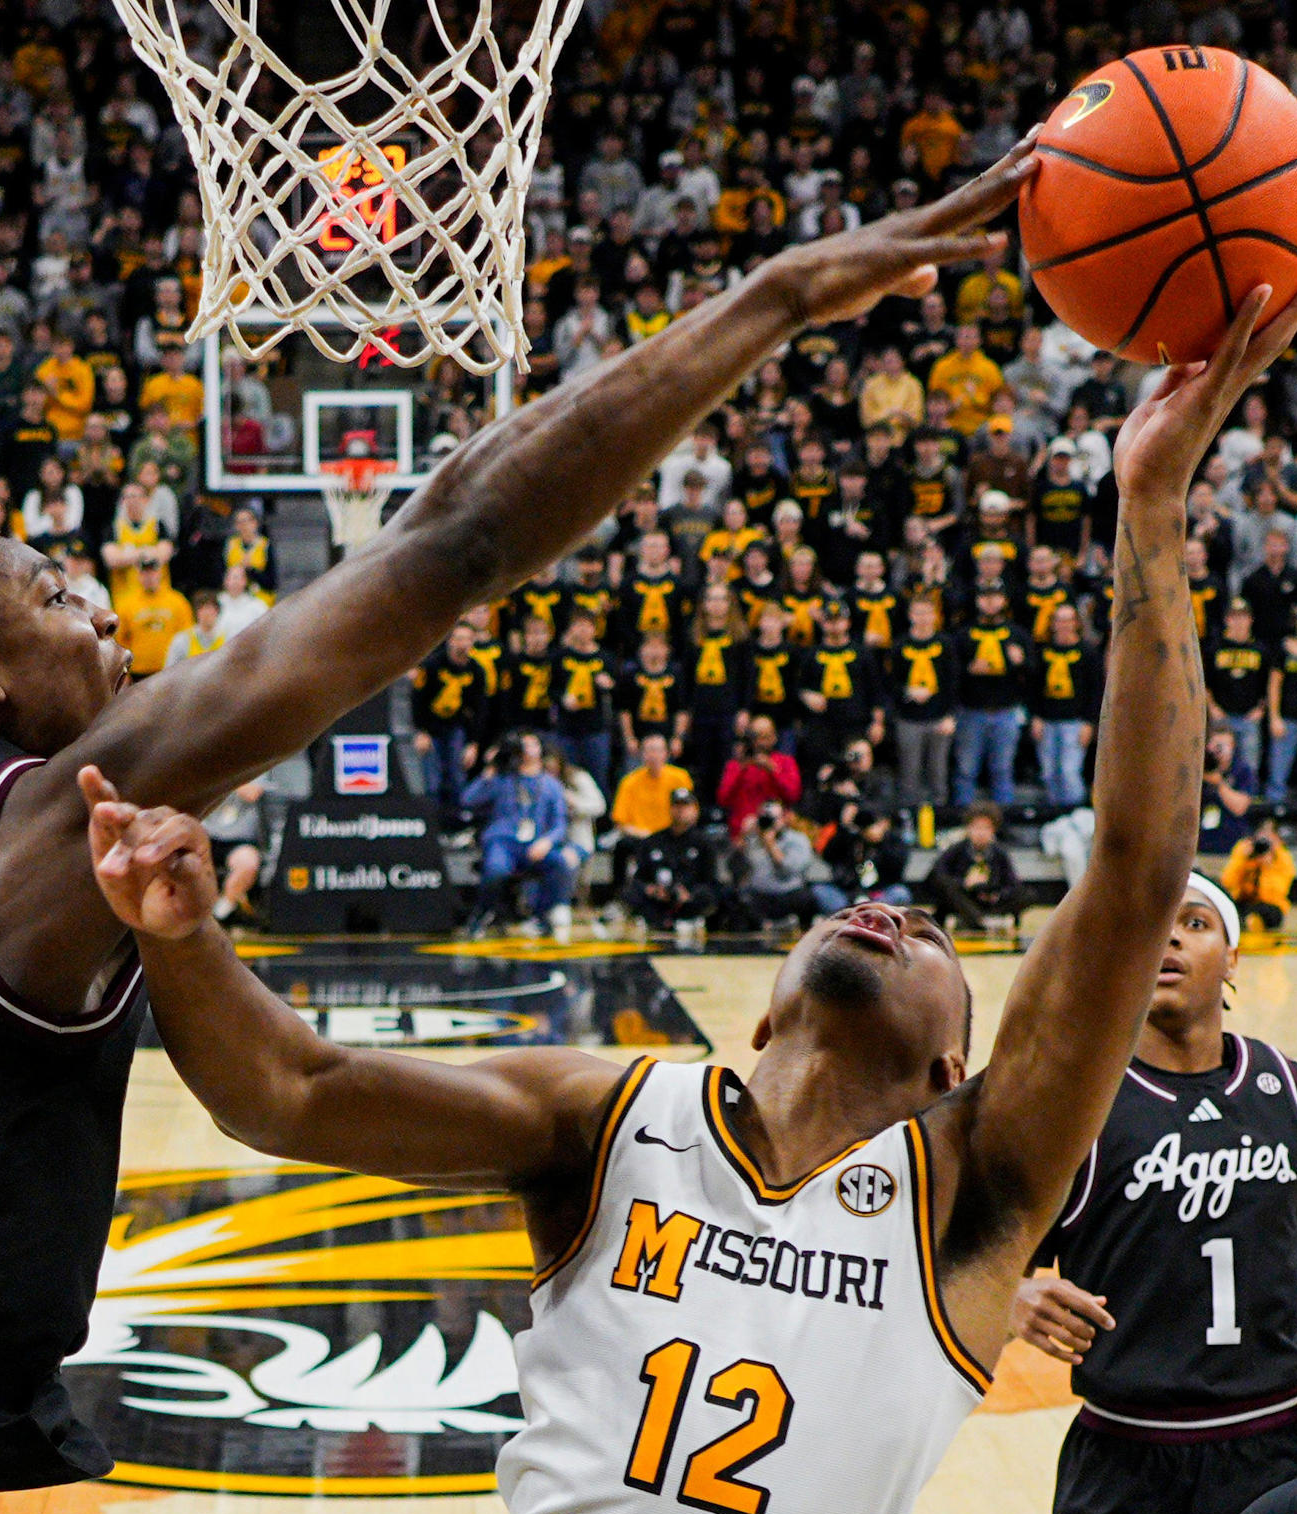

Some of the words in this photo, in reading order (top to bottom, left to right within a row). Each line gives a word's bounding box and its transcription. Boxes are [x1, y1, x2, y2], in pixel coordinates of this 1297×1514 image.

[314, 865, 387, 890] Health
[388, 863, 443, 889] Care
[838, 1165, 894, 1213] SEC
[1124, 1132, 1297, 1223] Aggies
[611, 1198, 888, 1310] MISSOURI
[1202, 1237, 1242, 1346] 1
